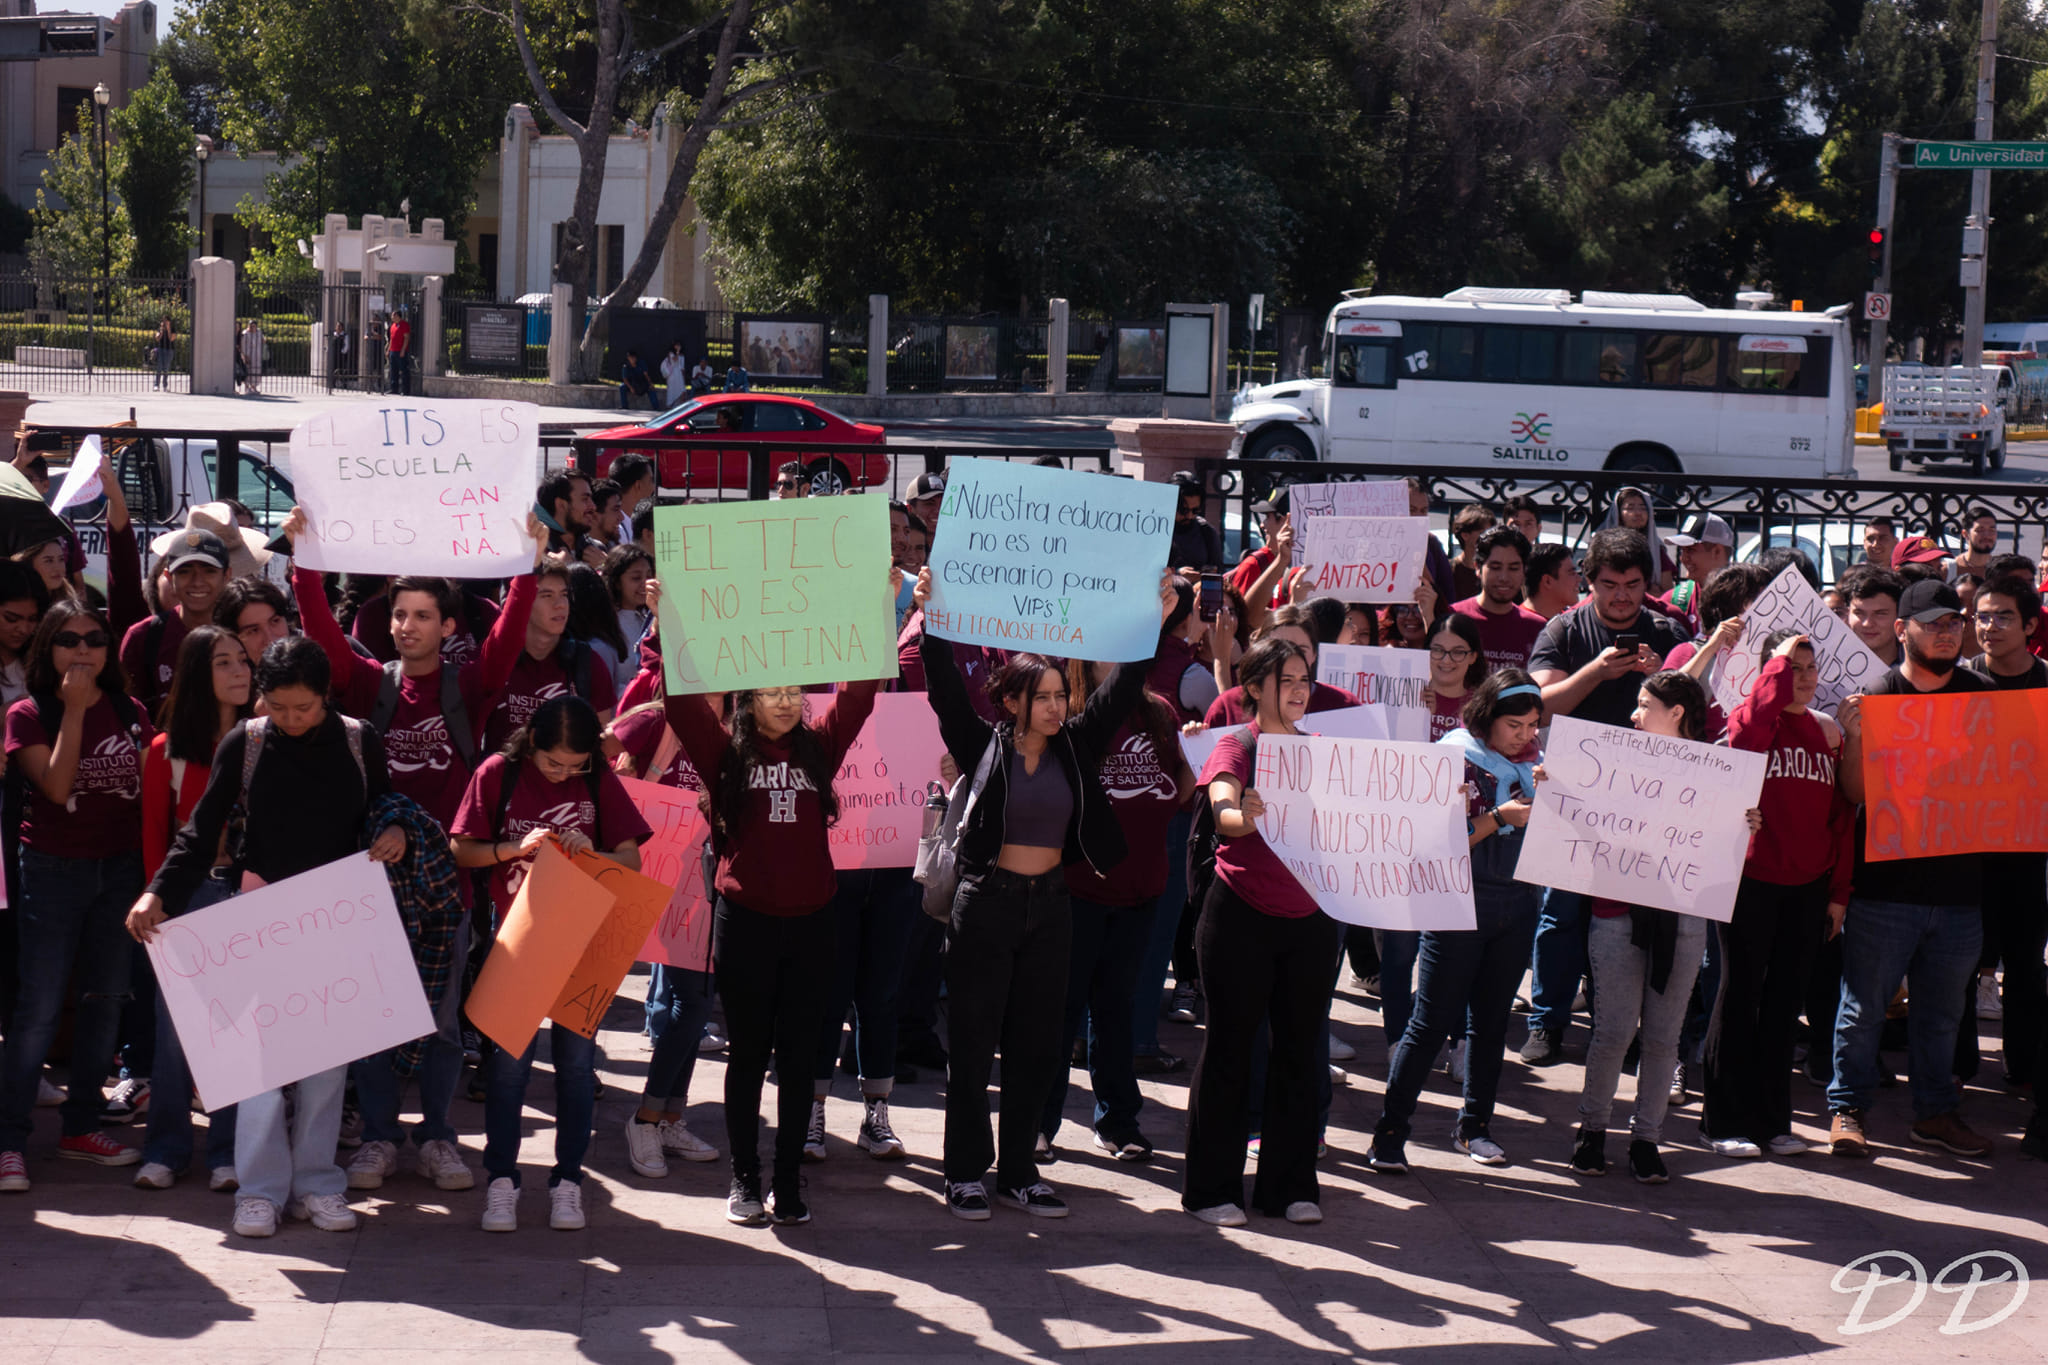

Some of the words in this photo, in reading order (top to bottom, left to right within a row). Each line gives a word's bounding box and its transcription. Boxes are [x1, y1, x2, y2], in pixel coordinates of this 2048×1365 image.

[1919, 148, 1940, 162] Av
[1949, 147, 2045, 163] Universidad
[308, 415, 347, 447] EL
[379, 408, 445, 447] ITS
[479, 406, 520, 444] ES
[1359, 407, 1370, 419] 02
[1492, 447, 1569, 462] SALTILLO
[1790, 441, 1811, 451] 072
[338, 452, 473, 480] ESCUELA
[439, 485, 500, 506] CAN
[303, 519, 354, 546] NO
[372, 519, 417, 545] ES
[452, 513, 488, 531] TI
[1058, 500, 1170, 537] educación
[1314, 520, 1340, 541] MI
[1345, 520, 1405, 540] ESCUELA
[452, 538, 500, 556] NA.
[736, 515, 853, 571] TEC
[969, 531, 997, 553] no
[1005, 534, 1030, 553] es
[1043, 534, 1068, 554] un
[943, 559, 1053, 590] escenario
[1062, 572, 1117, 596] para
[1315, 562, 1399, 593] ANTRO!
[700, 584, 740, 622] NO
[760, 575, 810, 615] ES
[926, 608, 1084, 645] #ELTECNOSETOCA
[1774, 571, 1802, 607] SI
[1800, 598, 1834, 641] NO
[1833, 633, 1869, 678] LO
[677, 623, 868, 684] CANTINA
[1892, 698, 1935, 742] SI
[1950, 695, 1994, 738] VA
[874, 757, 888, 778] ó
[1117, 774, 1164, 785] SALTILLO
[1256, 742, 1313, 792] #NO
[1326, 743, 1359, 797] AL
[1365, 747, 1453, 807] ABUSO
[1578, 738, 1618, 791] Si
[1630, 773, 1664, 799] va
[1678, 786, 1698, 808] a
[1868, 739, 2037, 791] TRONAR
[768, 789, 798, 822] H
[1551, 791, 1648, 835] Tronar
[1663, 825, 1704, 848] que
[1262, 801, 1292, 847] DE
[1310, 807, 1414, 857] NUESTRO
[1870, 799, 1906, 858] Q
[1352, 855, 1472, 899] ACADÉMICO
[1563, 839, 1701, 892] TRUENE
[208, 951, 395, 1048] Apoyo!
